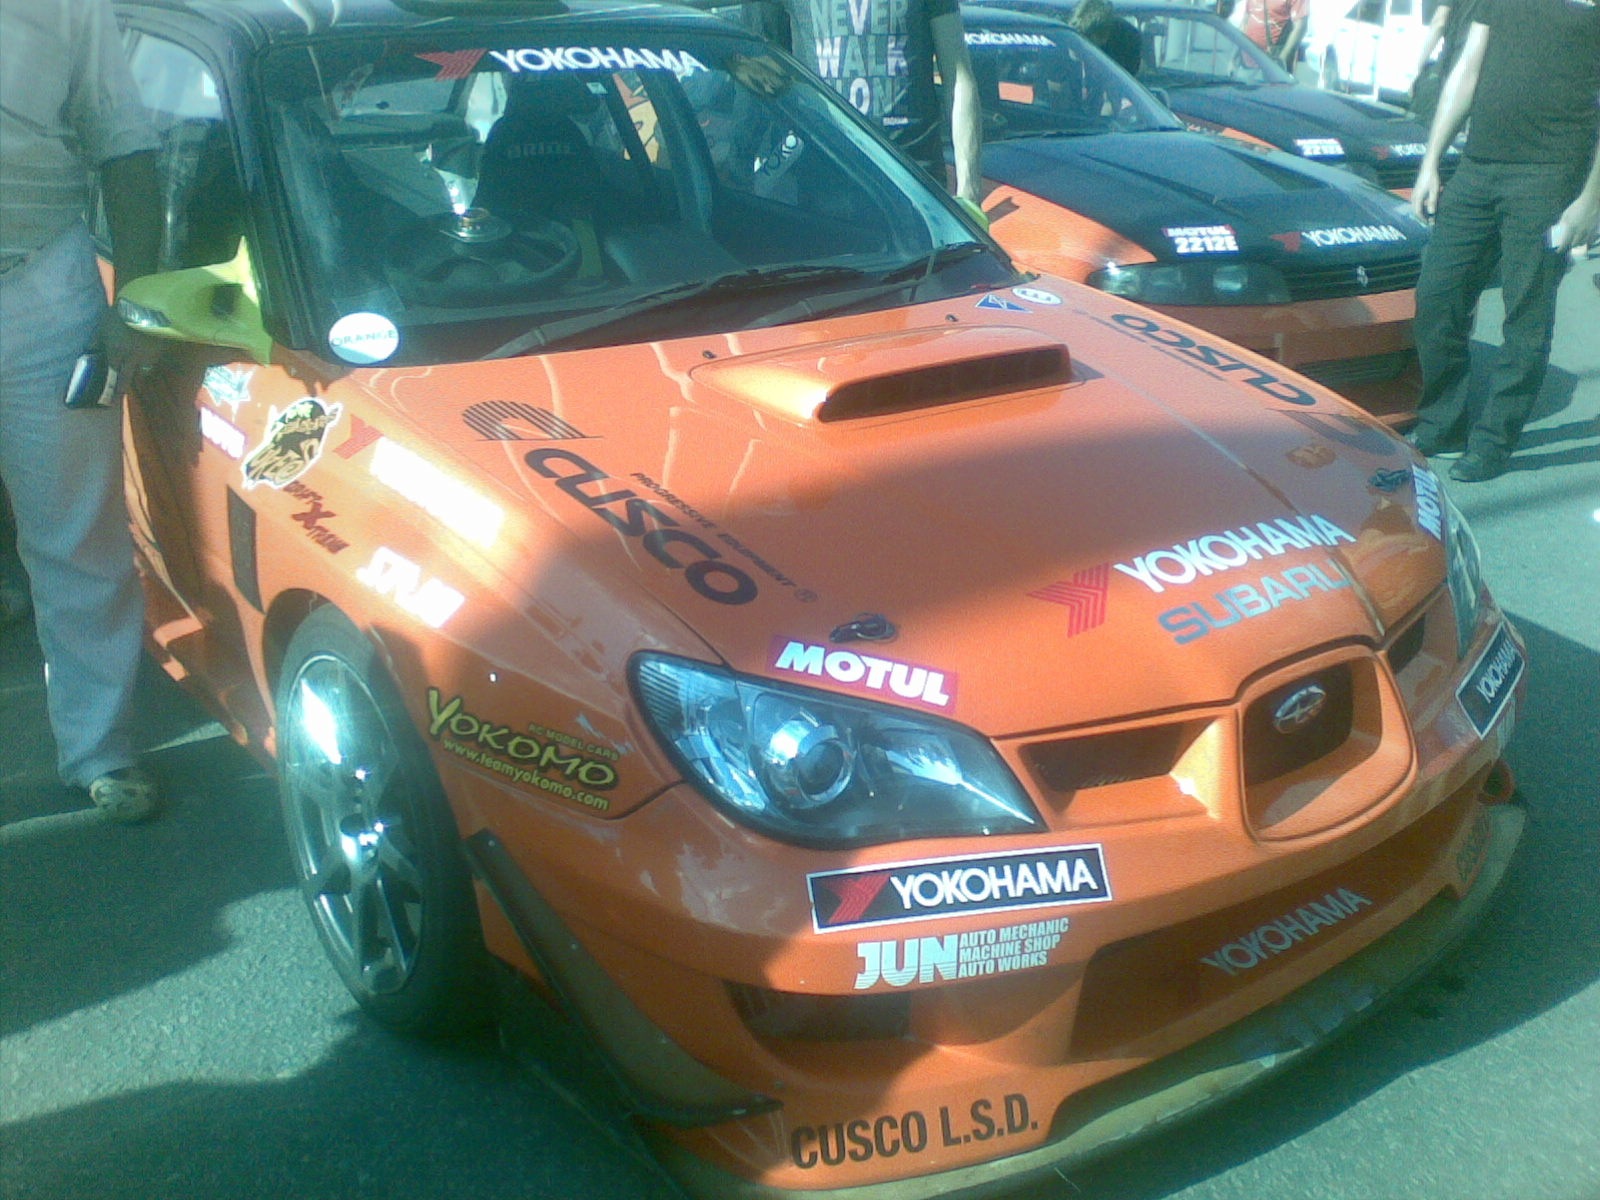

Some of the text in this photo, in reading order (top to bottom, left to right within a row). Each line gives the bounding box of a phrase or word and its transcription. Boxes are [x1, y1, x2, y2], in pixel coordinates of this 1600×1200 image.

[810, 0, 908, 35] NEVER
[490, 46, 709, 77] YOKOHAMA
[815, 35, 909, 78] WALK
[1174, 235, 1239, 254] 2212E
[1302, 225, 1407, 247] YOKOHAMA
[1114, 513, 1357, 593] YOKOHAMA
[1157, 556, 1354, 645] SUBARU
[775, 641, 950, 707] MOTUL
[443, 739, 610, 812] www.teamyokomo.com
[890, 857, 1099, 909] YOKOHAMA
[959, 917, 1070, 948] AUTO MECHANIC
[959, 934, 1062, 963] MACHINE SHOP
[1201, 887, 1372, 976] YOKOHAMA
[854, 934, 960, 990] JUN
[958, 951, 1048, 979] AUTO WORKS
[790, 1093, 1039, 1169] CUSCO L.S.D.
